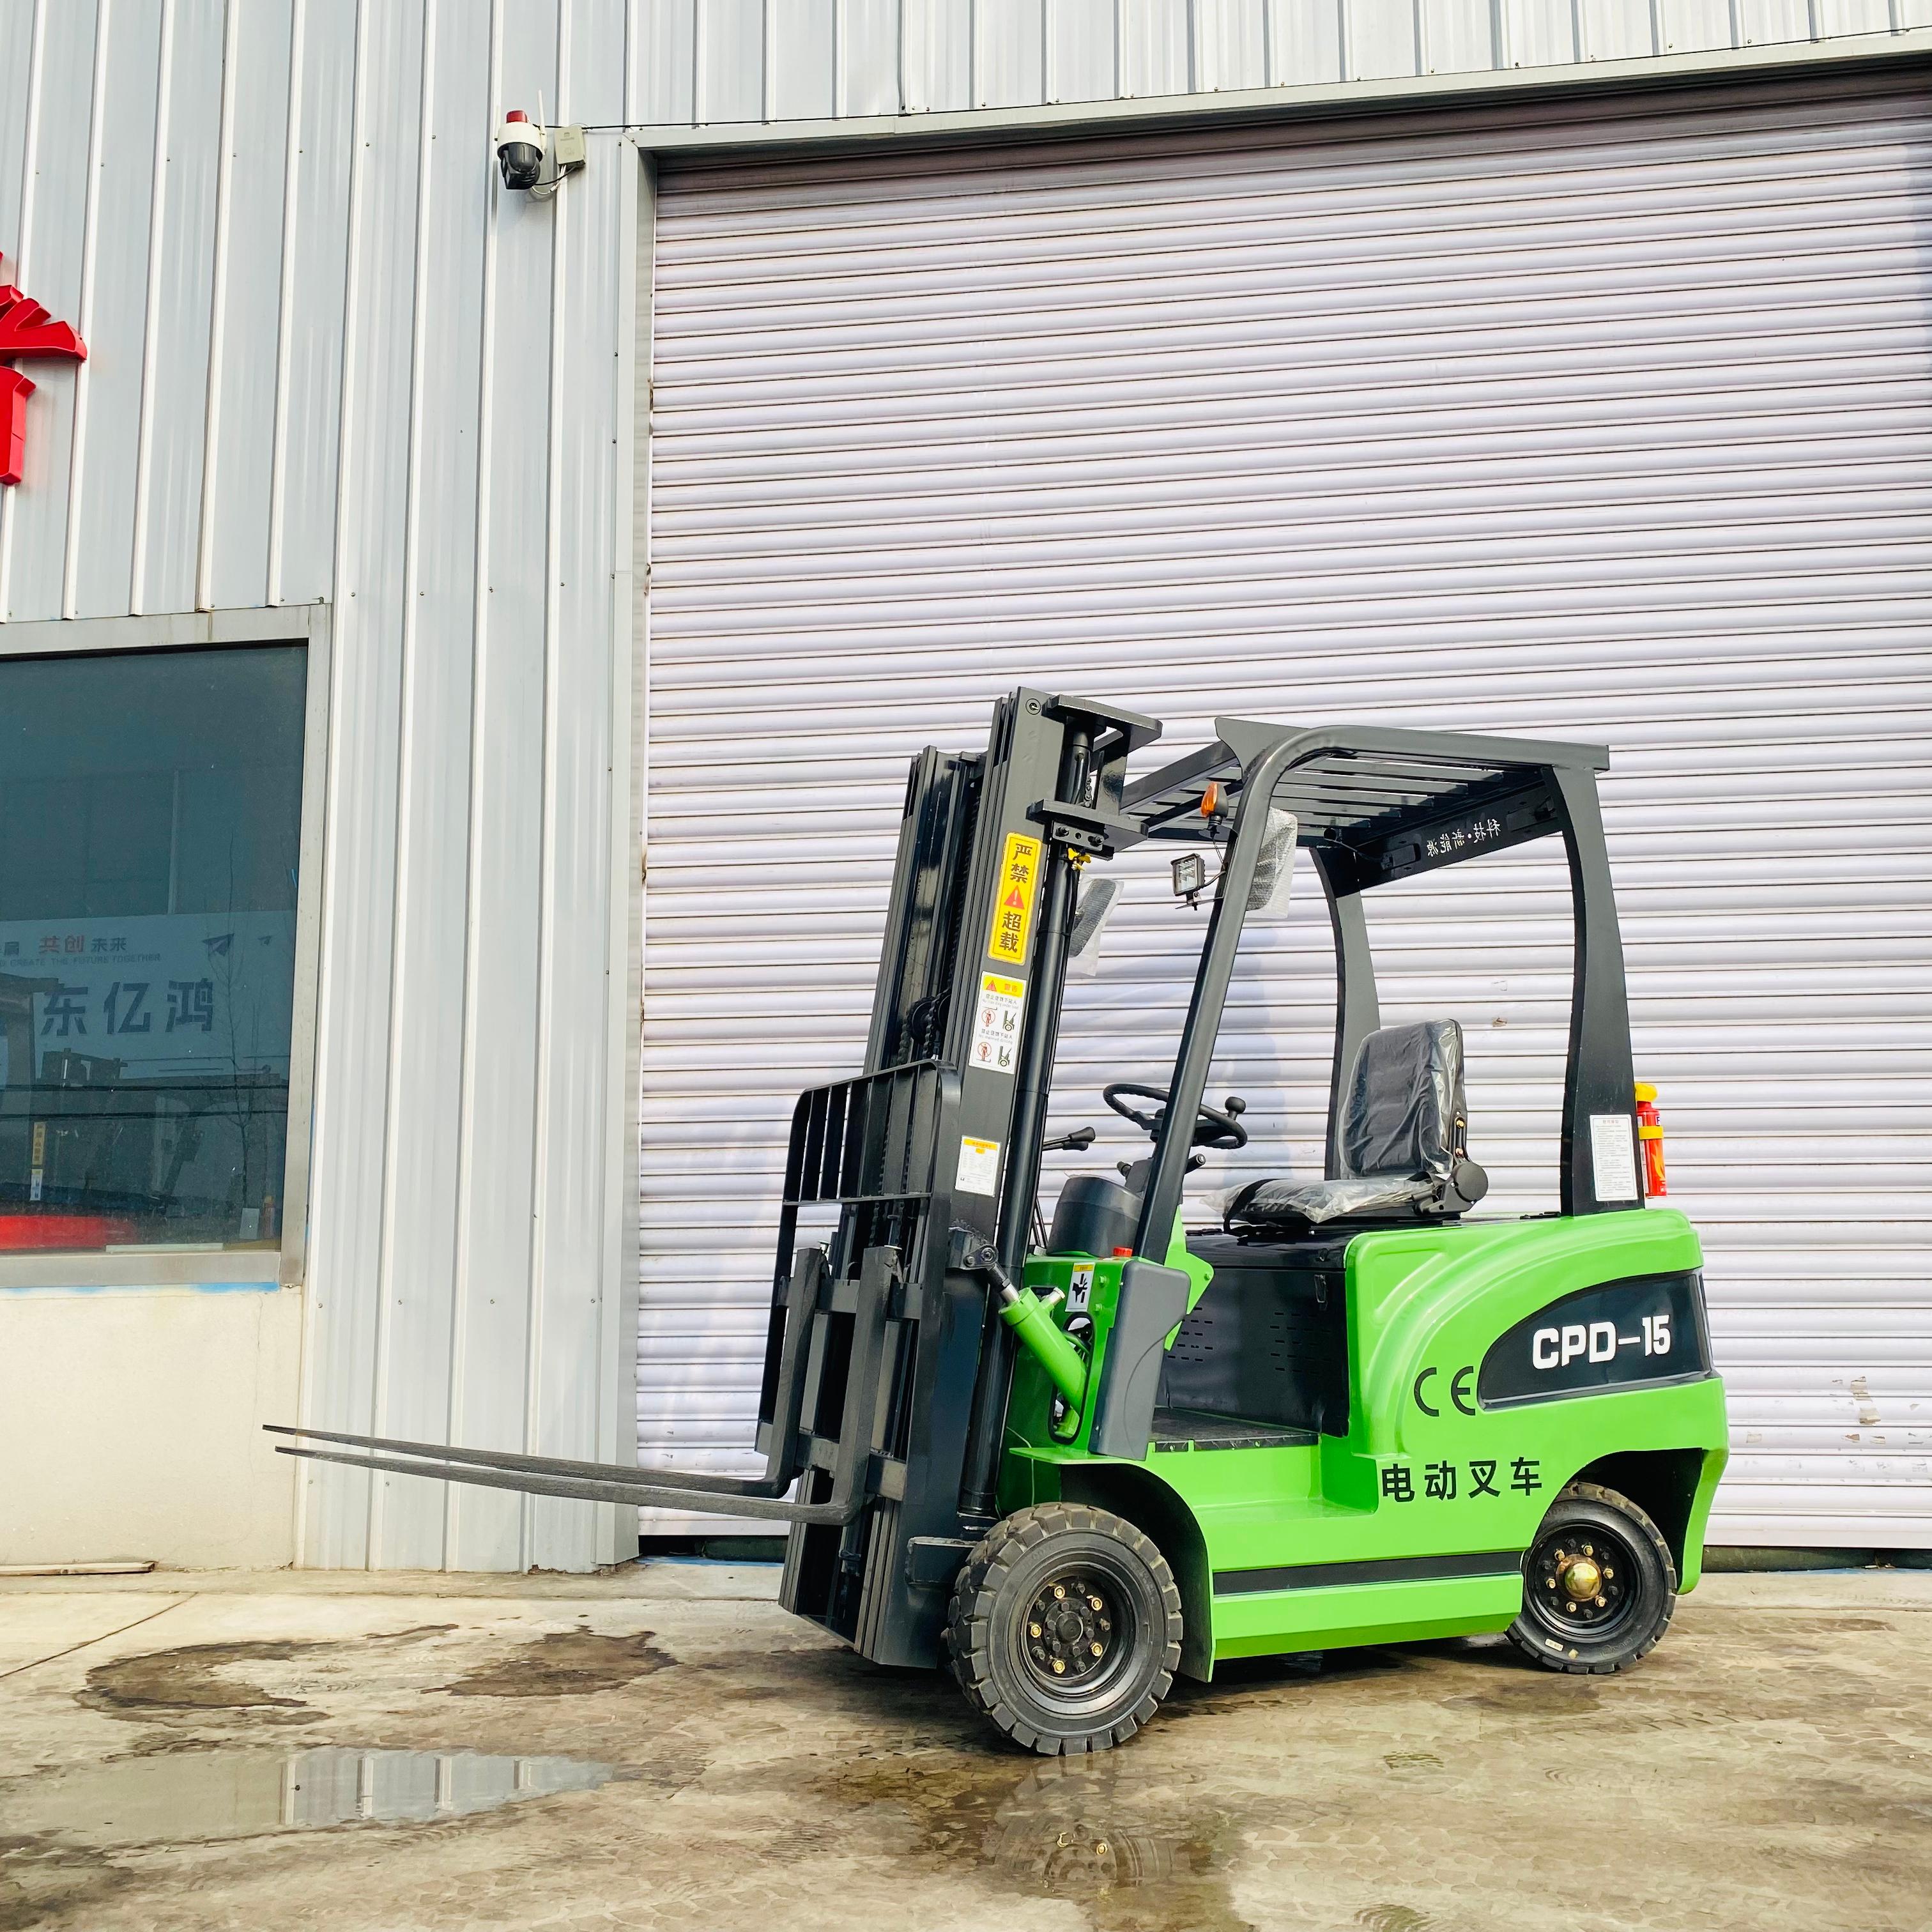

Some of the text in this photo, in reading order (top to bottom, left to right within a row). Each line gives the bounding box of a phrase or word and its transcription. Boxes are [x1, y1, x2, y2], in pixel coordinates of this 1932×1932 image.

[999, 843, 1032, 953] 严禁 超载
[39, 935, 127, 954] 共创未来
[40, 977, 213, 1036] 东亿鸿
[1533, 1314, 1671, 1370] CPD-15
[1414, 1366, 1476, 1416] CE
[1381, 1457, 1542, 1503] 电动叉车
